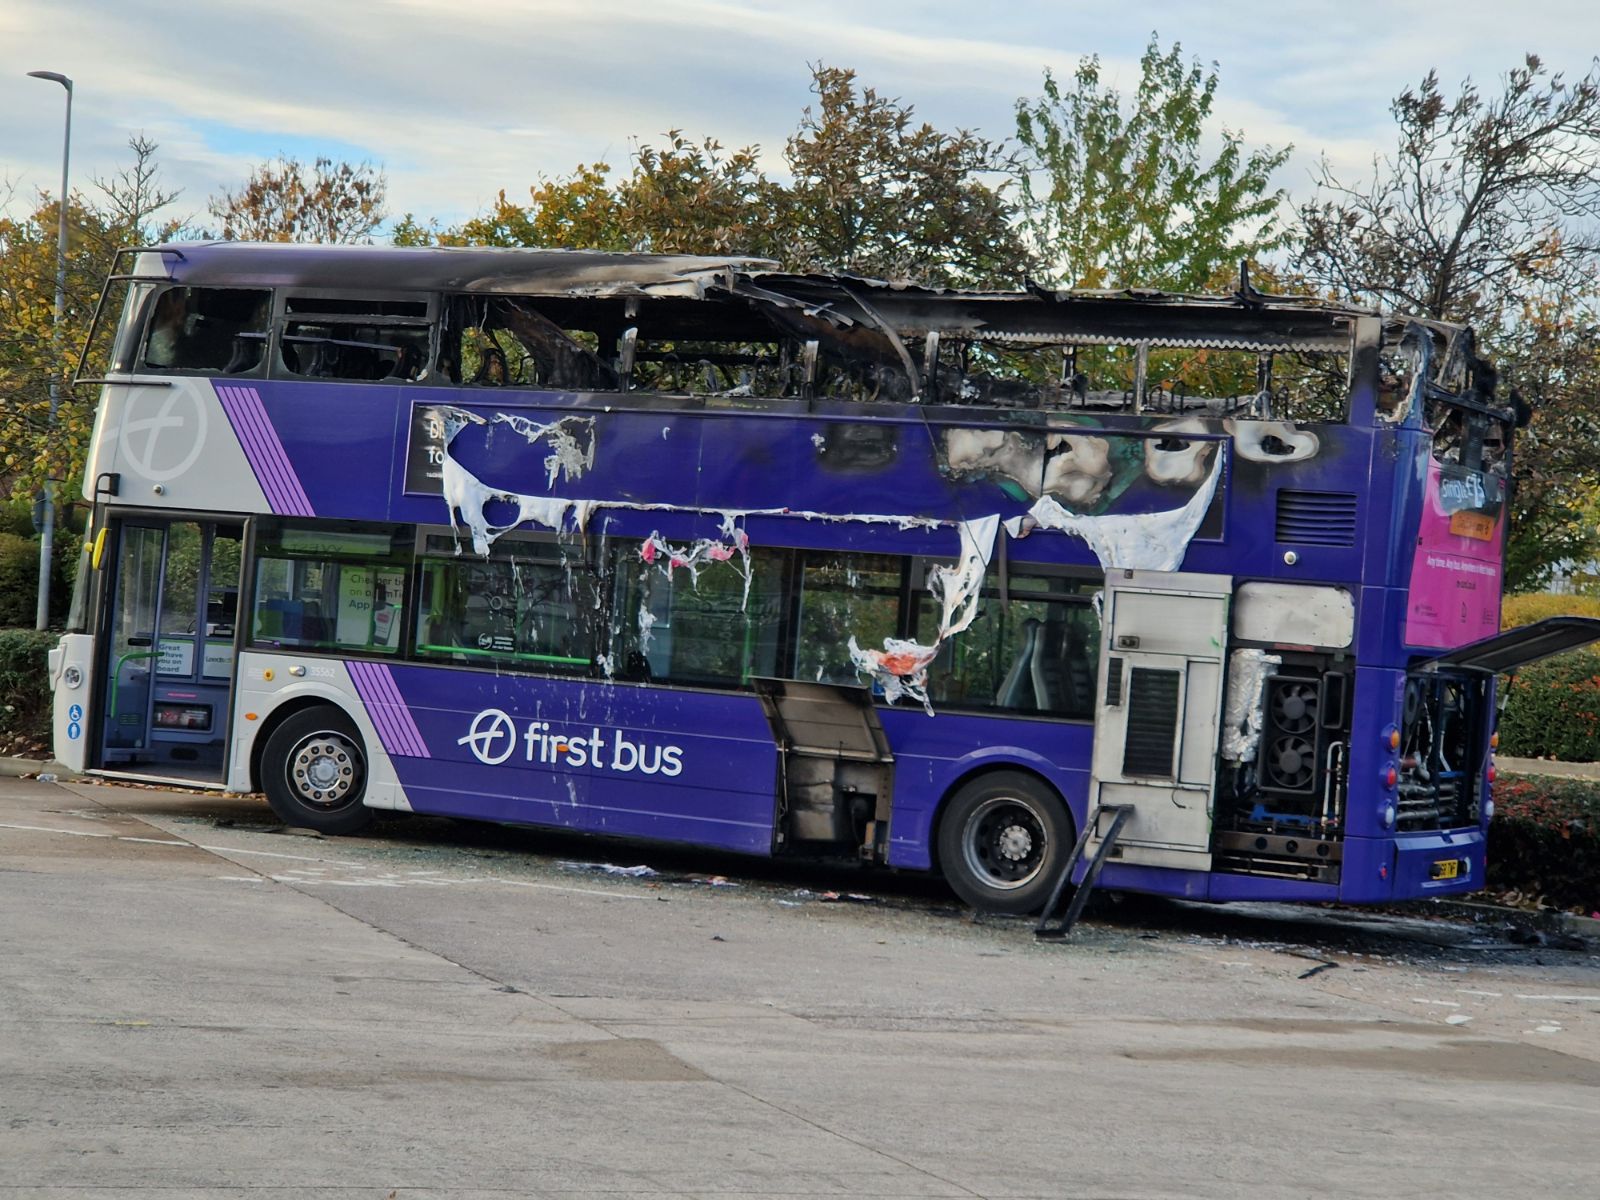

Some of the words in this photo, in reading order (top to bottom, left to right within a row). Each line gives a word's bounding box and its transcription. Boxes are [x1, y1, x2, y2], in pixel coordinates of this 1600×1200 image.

[351, 574, 393, 586] Cheper
[349, 600, 370, 611] App
[524, 722, 604, 768] first
[611, 730, 684, 777] bus
